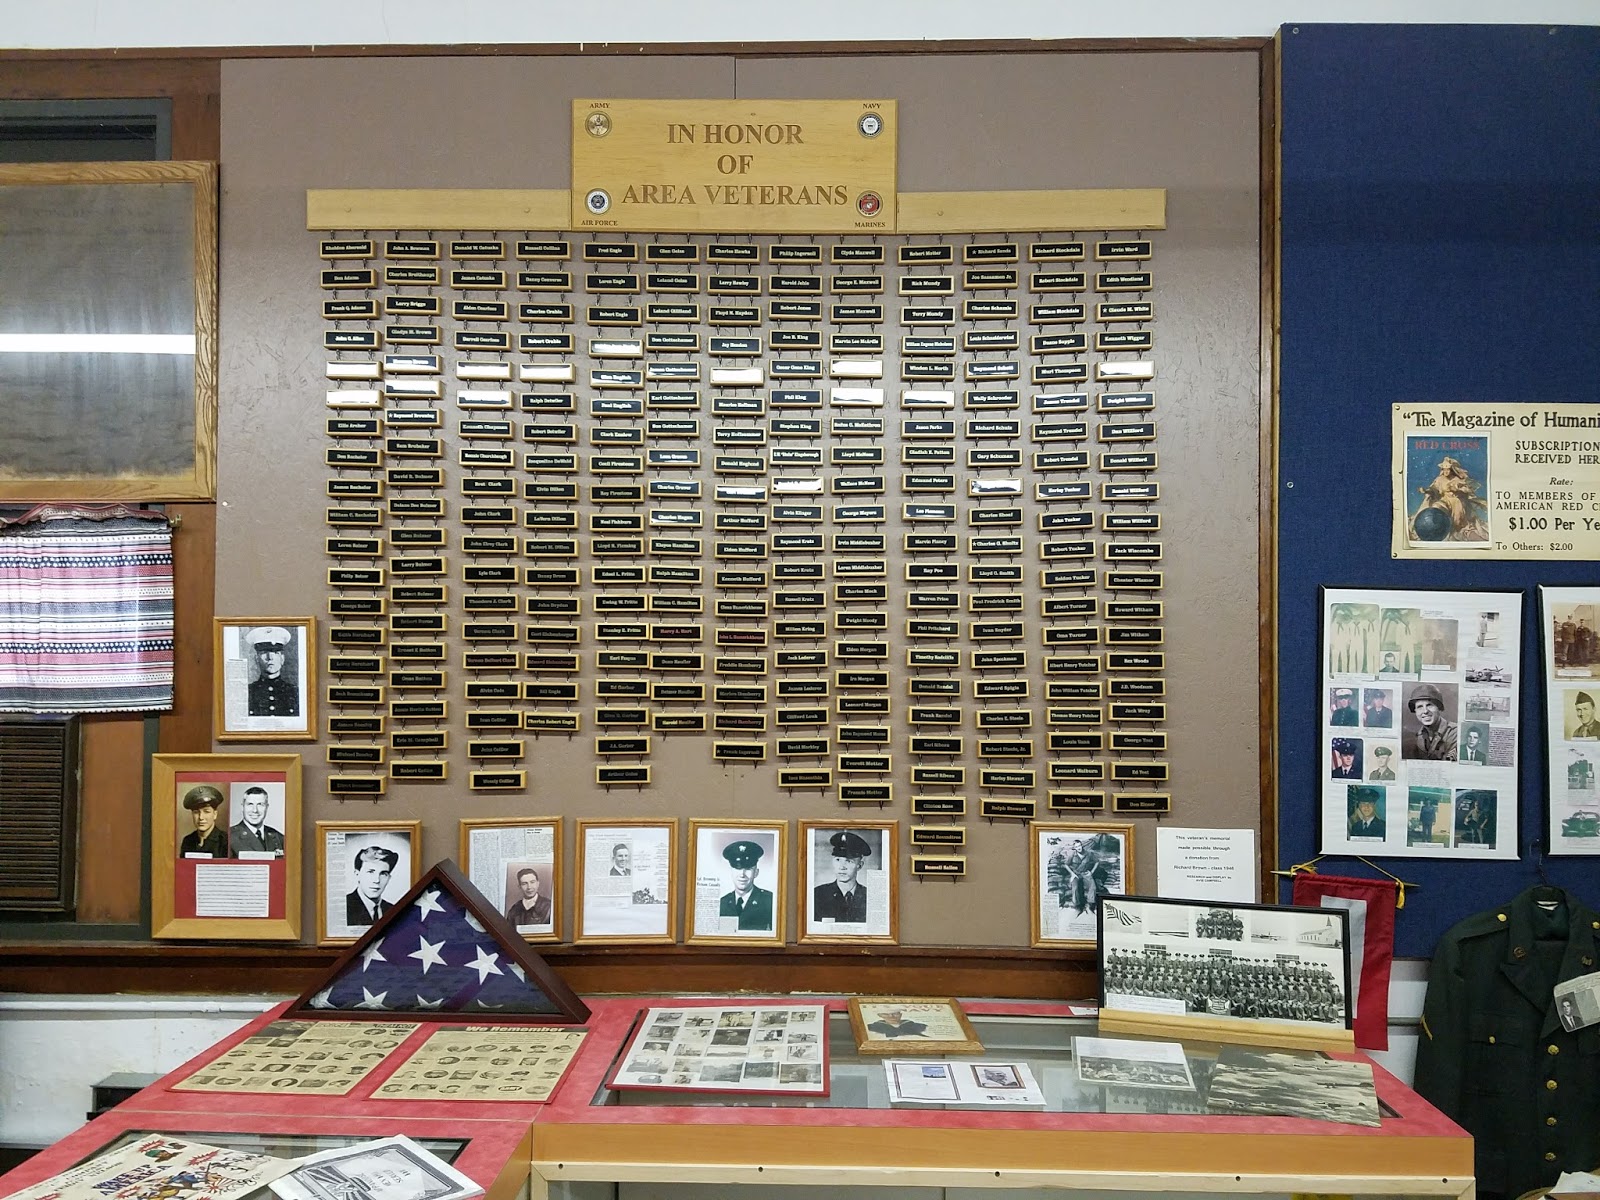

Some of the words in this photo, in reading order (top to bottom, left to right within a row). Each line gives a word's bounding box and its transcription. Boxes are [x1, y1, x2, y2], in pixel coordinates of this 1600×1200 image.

[667, 124, 695, 144] IN
[704, 124, 803, 144] HONOR
[718, 155, 753, 174] OF
[622, 185, 696, 204] AREA
[704, 185, 848, 205] VETERANS
[1442, 412, 1514, 428] Magazine
[1520, 412, 1538, 426] of
[1415, 441, 1439, 449] RED
[1515, 441, 1600, 451] SUBSCRIPTION
[1515, 454, 1571, 463] RECEIVED
[1578, 455, 1600, 464] HER
[1549, 477, 1573, 485] Rate:
[1519, 492, 1573, 500] MEMBERS
[1496, 502, 1553, 510] AMERICAN
[1509, 517, 1547, 531] $1.00
[1555, 518, 1575, 530] Per
[1512, 542, 1543, 550] Others:
[1550, 543, 1573, 551] $2.00
